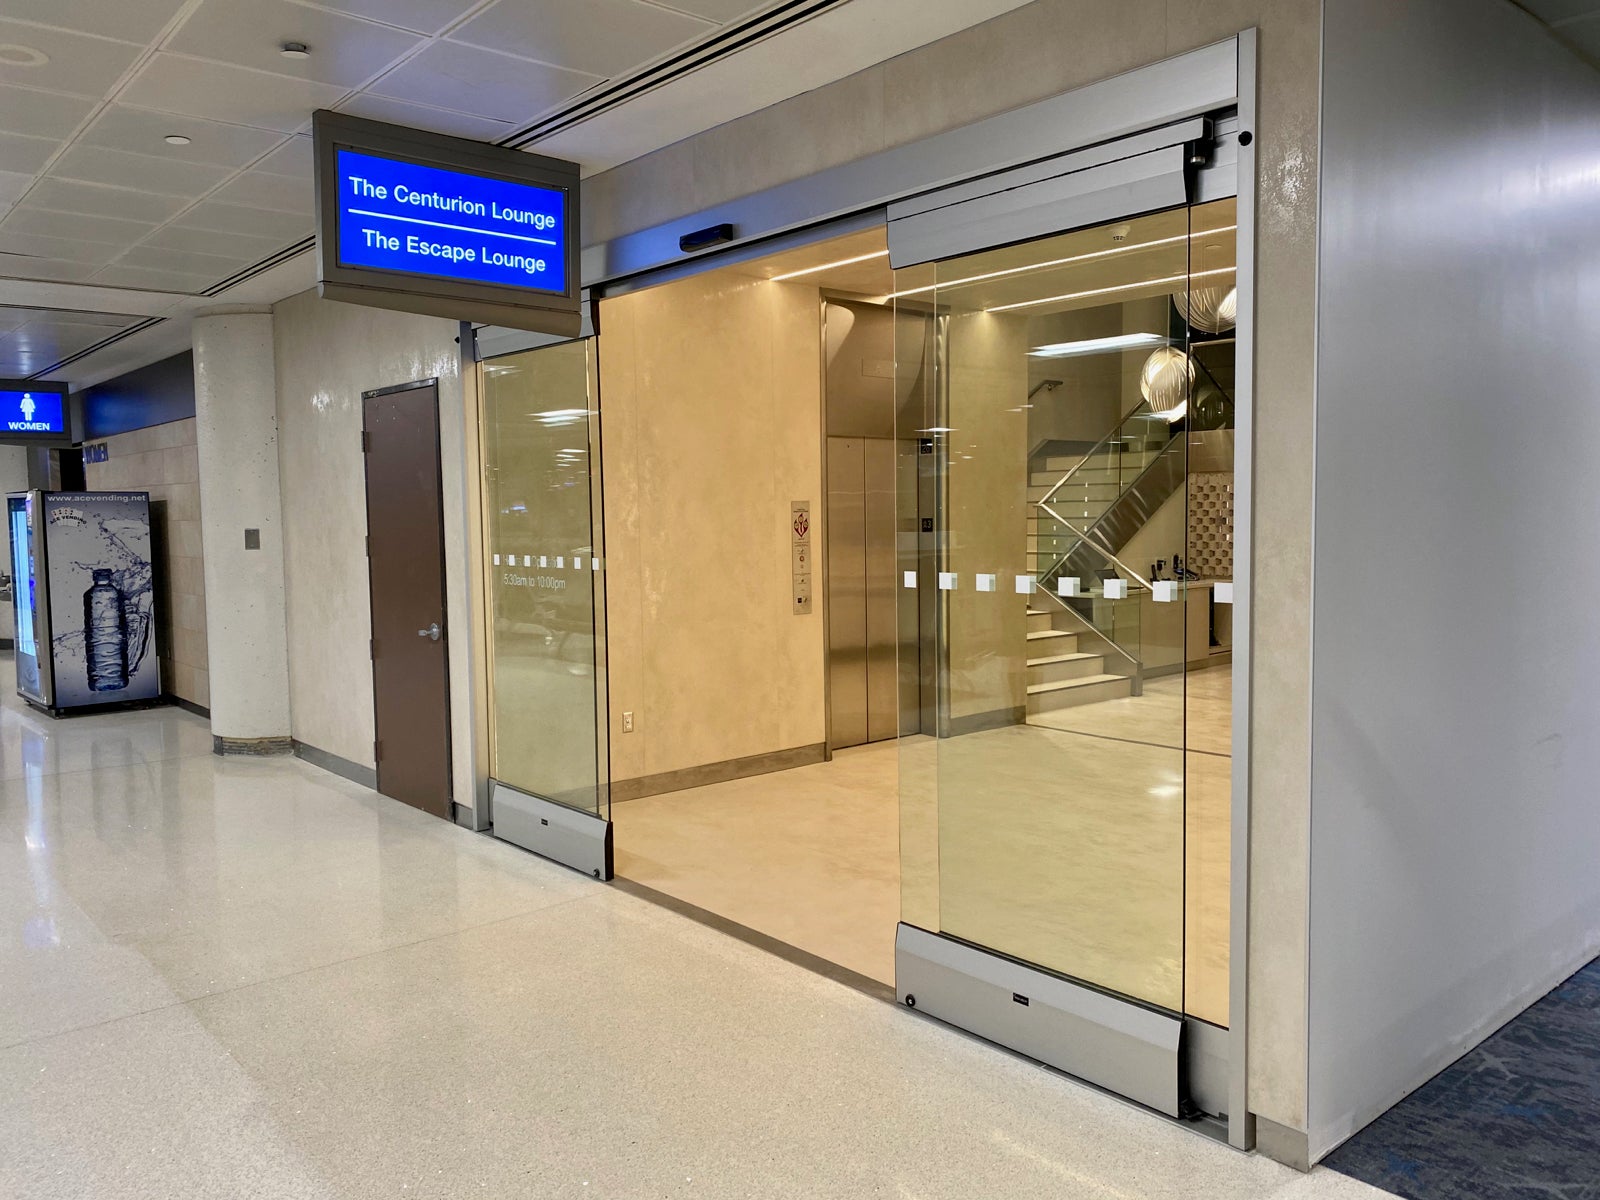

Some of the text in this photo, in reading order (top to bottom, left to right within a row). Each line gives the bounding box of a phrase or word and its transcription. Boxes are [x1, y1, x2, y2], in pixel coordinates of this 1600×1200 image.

[349, 176, 556, 231] The Centurion Lounge
[362, 228, 546, 274] The Escape Lounge
[8, 421, 50, 431] WOMEN
[503, 574, 566, 591] 5:30am to 10:00pm
